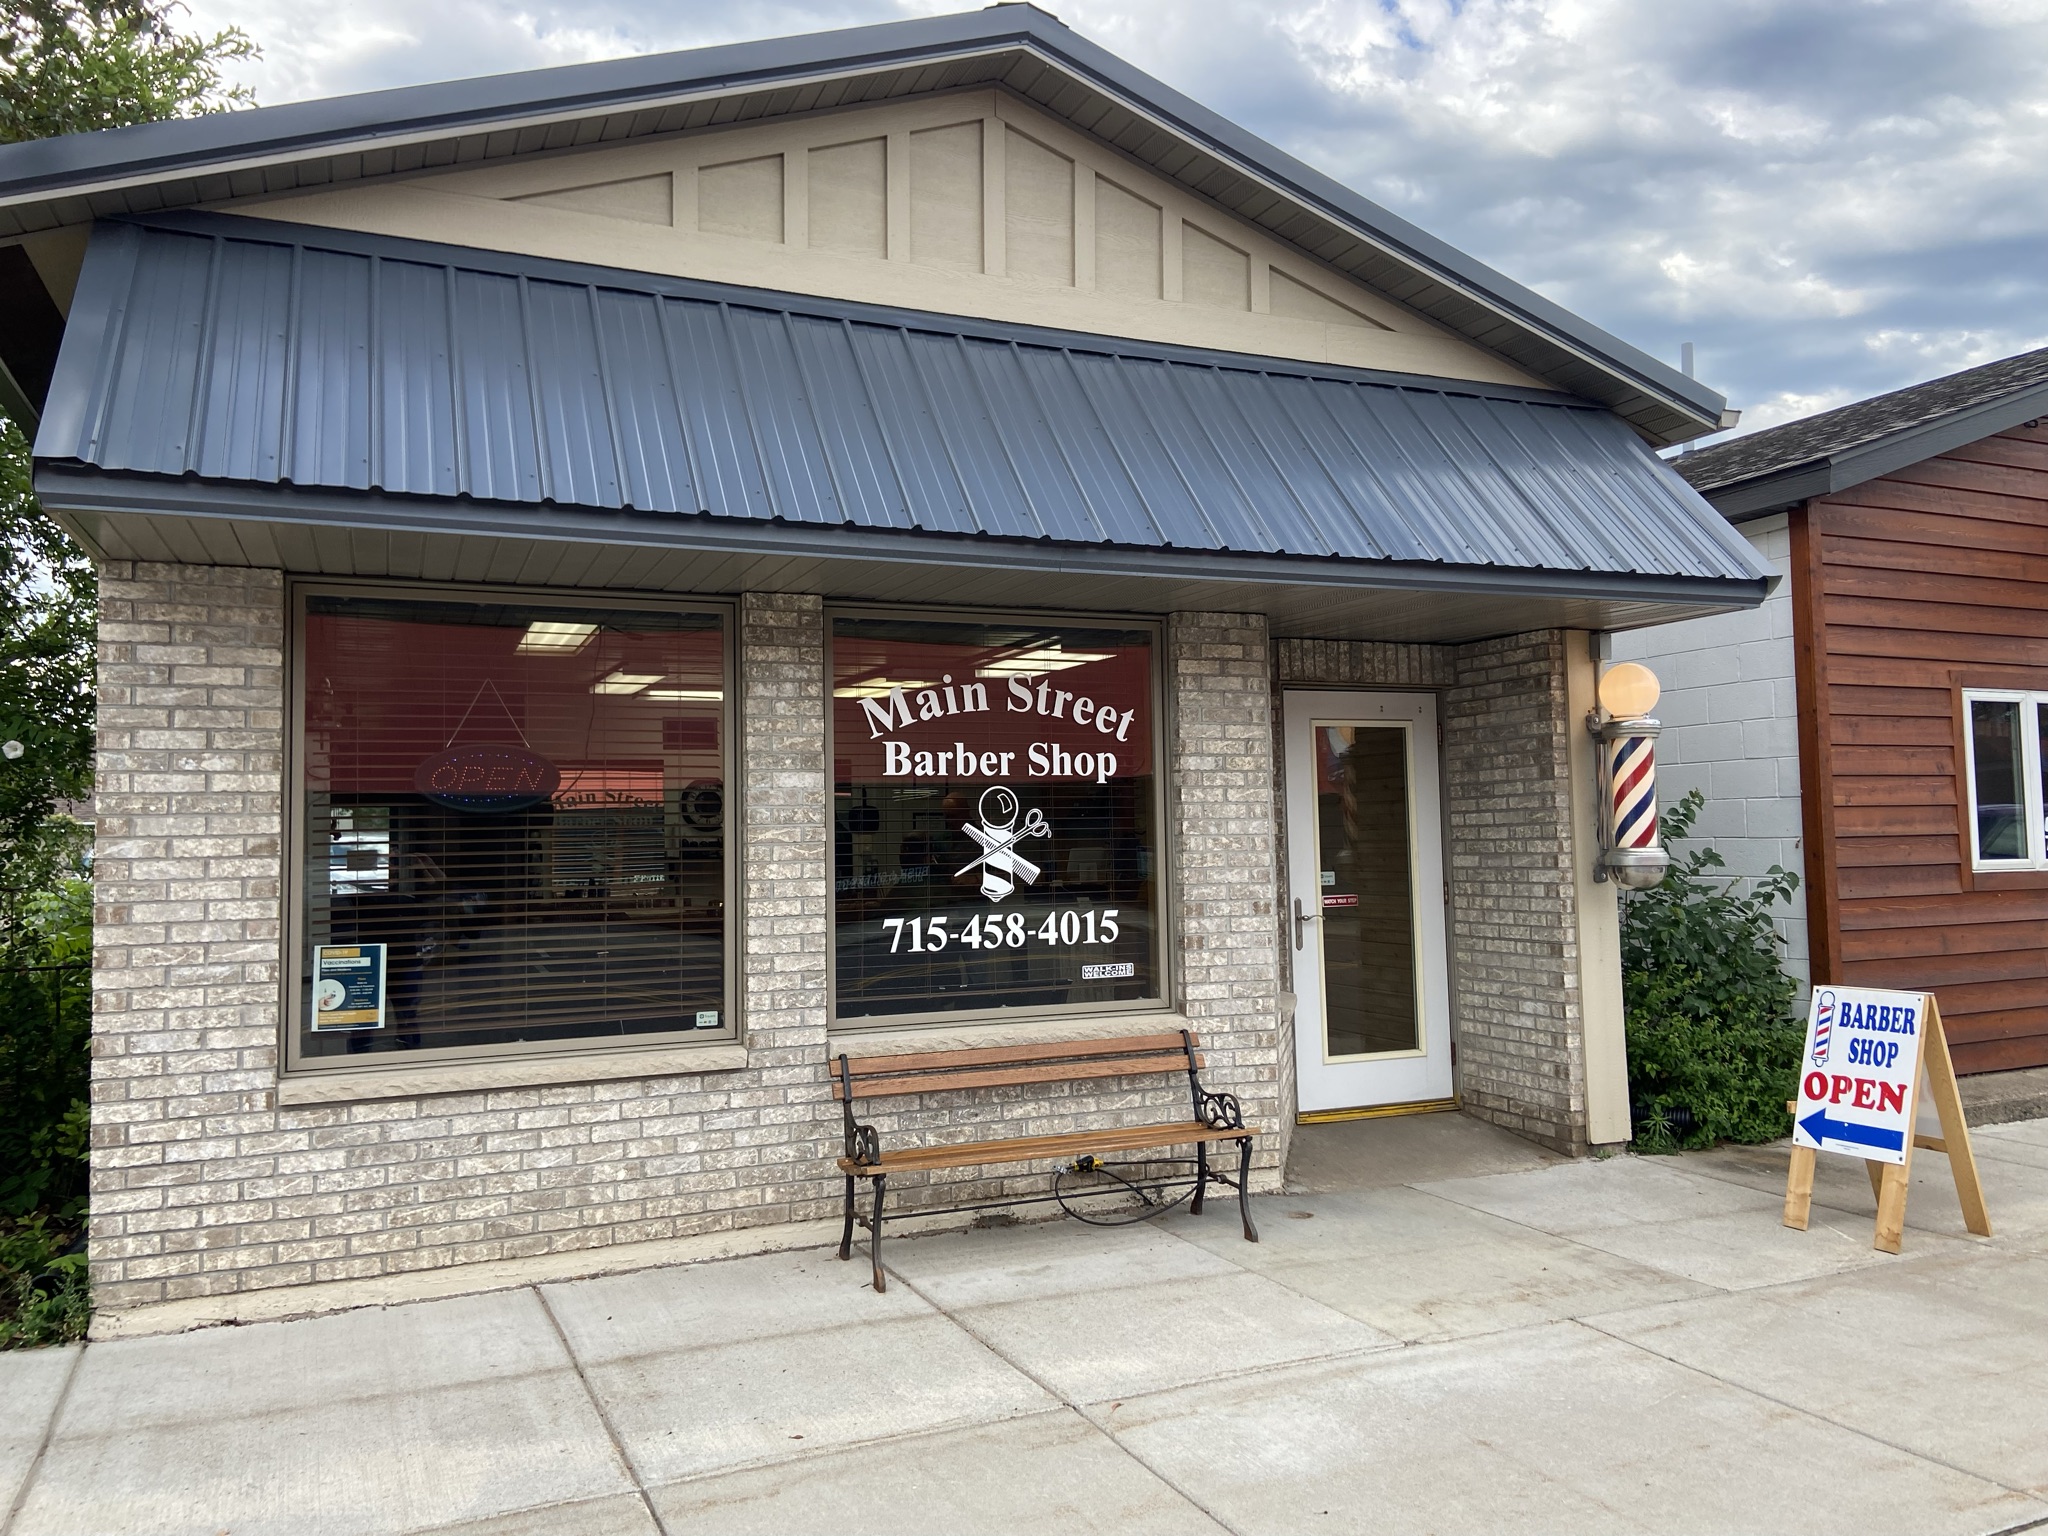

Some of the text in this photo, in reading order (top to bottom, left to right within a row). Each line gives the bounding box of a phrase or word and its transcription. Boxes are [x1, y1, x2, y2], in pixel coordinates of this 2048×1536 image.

[856, 672, 1135, 742] Main Street
[431, 765, 545, 791] OPEN
[882, 741, 1117, 784] Barber Shop
[882, 909, 1119, 954] 715-458-4015
[1084, 964, 1132, 973] WALK-INS
[1084, 970, 1132, 978] WELCOME
[1839, 1002, 1916, 1035] BARBER
[1848, 1037, 1899, 1068] SHOP
[1804, 1071, 1908, 1115] OPEN
